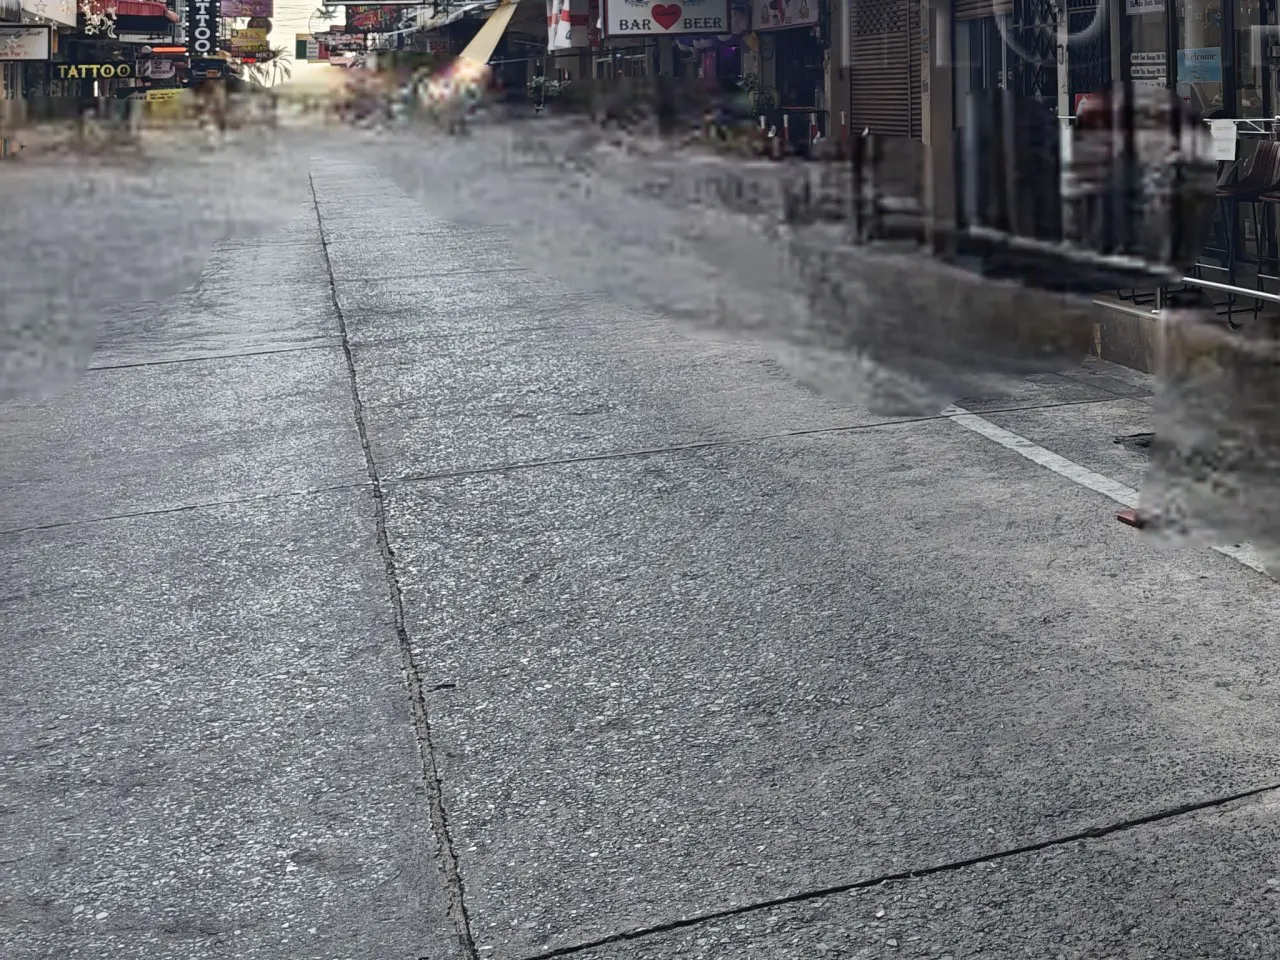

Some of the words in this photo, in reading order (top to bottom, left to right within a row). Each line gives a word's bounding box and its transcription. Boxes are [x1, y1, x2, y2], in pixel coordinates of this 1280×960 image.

[620, 19, 651, 30] BAR
[684, 17, 722, 30] BEER
[1184, 52, 1216, 60] Welcome
[58, 64, 130, 78] TATTOO
